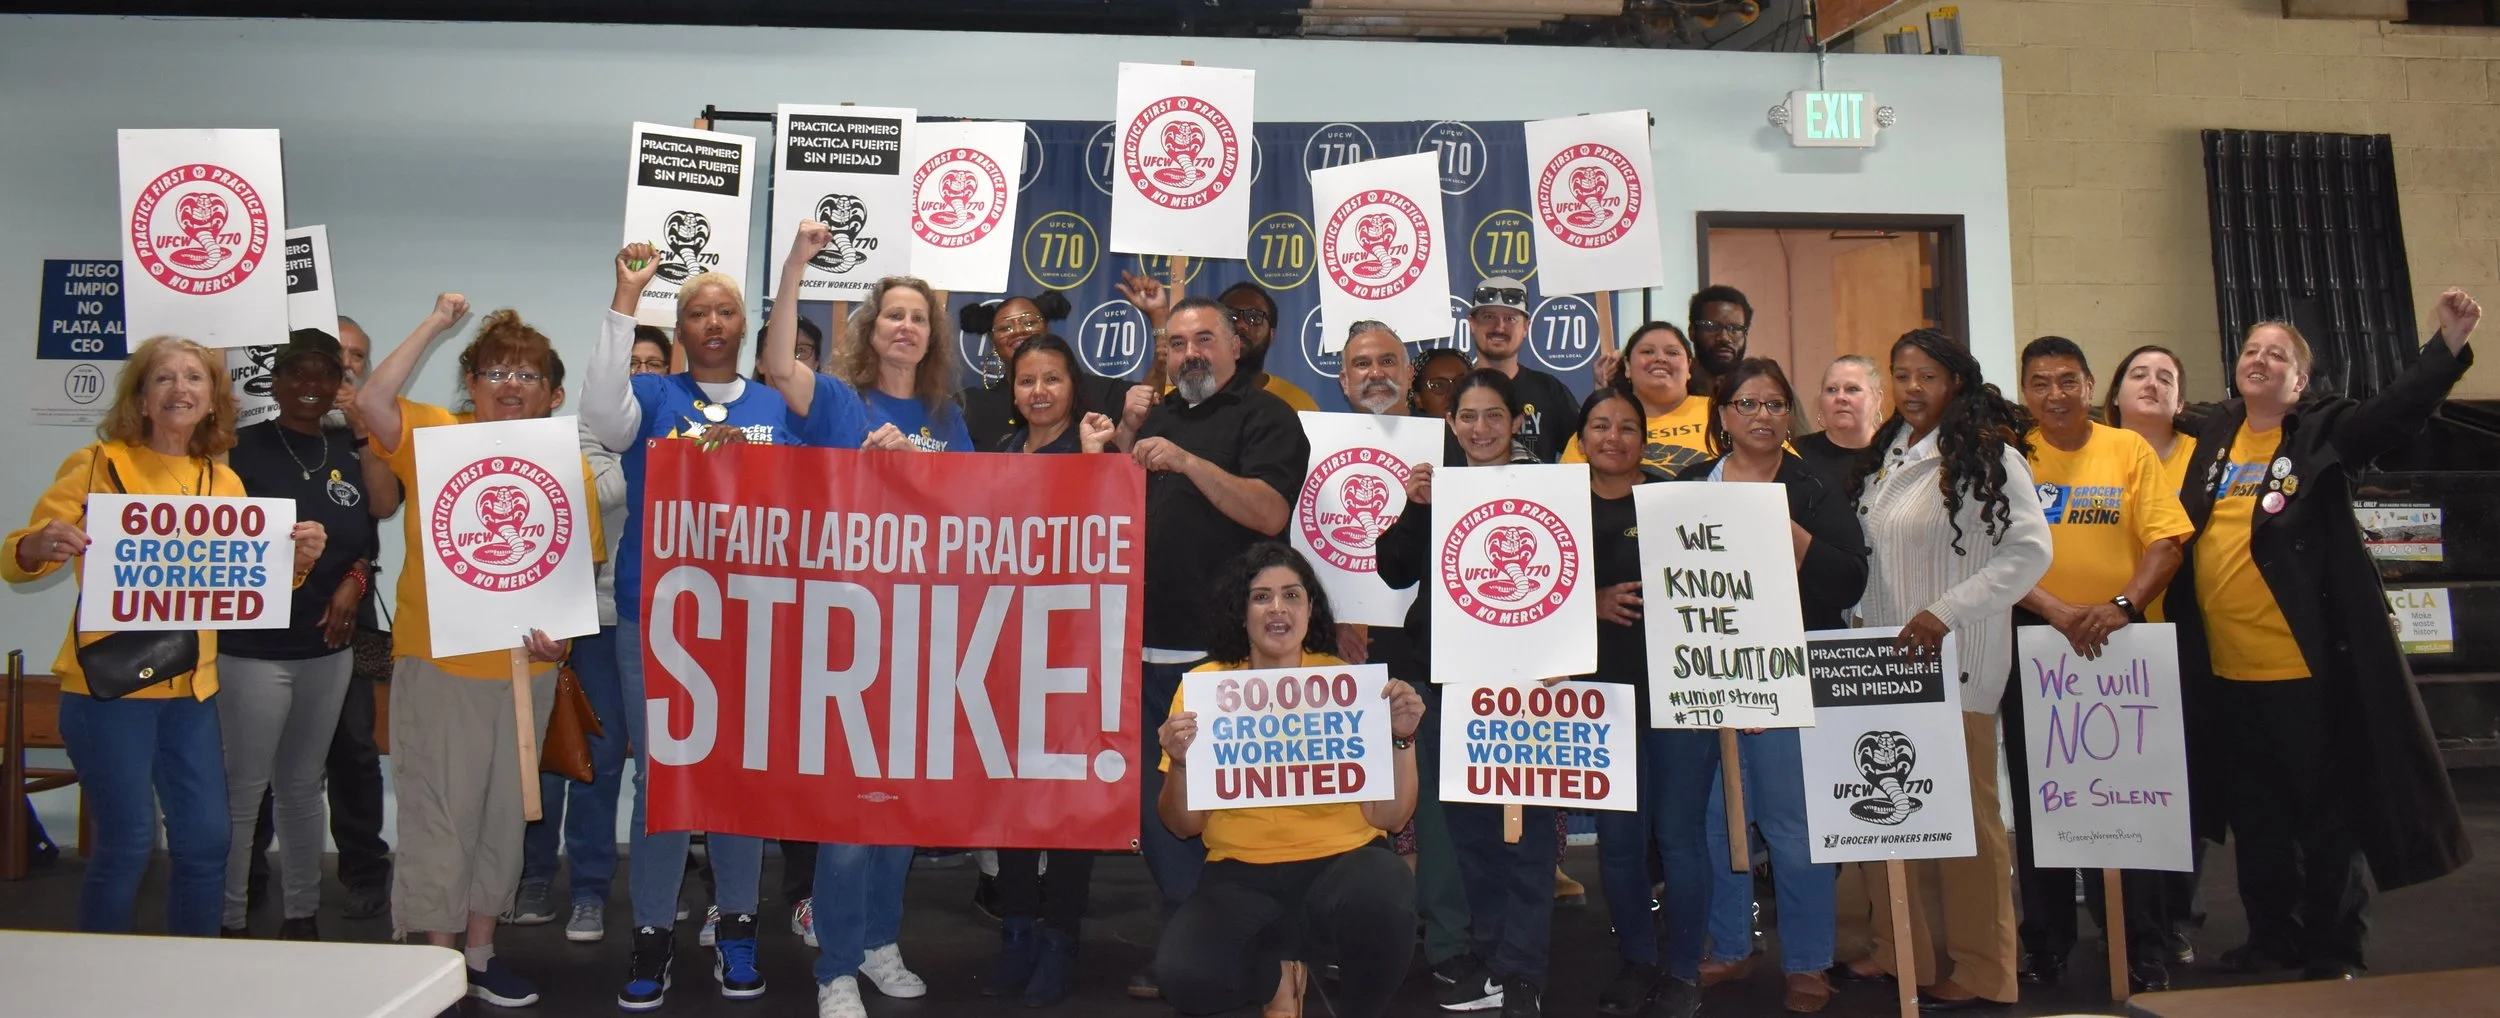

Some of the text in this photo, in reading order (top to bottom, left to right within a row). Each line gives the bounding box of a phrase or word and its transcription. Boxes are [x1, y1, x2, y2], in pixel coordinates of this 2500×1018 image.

[1806, 93, 1863, 138] EXIT
[790, 121, 899, 135] PRACTICA PRIMERO
[1127, 100, 1171, 174] PRACTICE FIRST
[1440, 129, 1463, 137] UFCW
[642, 139, 739, 159] PRACTICA PRIMERO
[789, 136, 899, 151] PRACTICA FUERTE
[1193, 102, 1236, 177] PRACTICE HARD
[641, 154, 739, 174] PRACTICA FUERTE
[804, 151, 882, 166] SIN PIEDAD
[926, 152, 952, 172] FIRST
[1143, 156, 1215, 168] UFCW 770
[1431, 140, 1471, 176] 770
[654, 169, 724, 187] SIN PIEDAD
[969, 153, 1005, 219] PRACTICE HARD
[1540, 149, 1574, 221] PRACTICE FIRST
[1594, 147, 1639, 213] PRACTICE HARD
[921, 201, 985, 211] UFCW 770
[1151, 190, 1208, 207] NO MERCY
[1556, 196, 1620, 213] UFCW 770
[134, 169, 185, 258] PRACTICE FIRST
[211, 169, 265, 254] PRACTICE HARD
[1325, 196, 1361, 272] PRACTICE FIRST
[1382, 193, 1428, 261] PRACTICE HARD
[1567, 228, 1618, 246] NO MERCY
[156, 233, 241, 248] UFCW 770
[855, 237, 878, 250] 770
[925, 231, 975, 246] NO MERCY
[1487, 231, 1529, 265] 770
[699, 253, 719, 265] 770
[1040, 233, 1084, 269] 770
[1260, 234, 1304, 269] 770
[1341, 244, 1408, 264] UFCW 770
[66, 264, 119, 278] JUEGO
[286, 258, 312, 271] ERTE
[64, 282, 119, 296] LIMPIO
[169, 271, 236, 292] NO MERCY
[799, 280, 862, 289] ROCERY WORKERS
[1352, 277, 1406, 297] NO MERCY
[642, 290, 673, 299] GROCERY
[77, 301, 103, 315] NO
[52, 320, 125, 334] PLATA AL
[1544, 315, 1586, 350] 770
[71, 339, 104, 353] CEO
[1095, 321, 1136, 358] 770
[73, 376, 96, 393] 770
[231, 366, 260, 381] UFCW
[740, 424, 774, 434] OCERY
[1647, 424, 1702, 439] ESIST
[1302, 451, 1353, 531] PRACTICE FIRST
[2074, 486, 2124, 497] GROCERY
[435, 463, 483, 557] PRACTICE FIRST
[510, 461, 569, 544] PRACTICE HARD
[120, 502, 265, 538] 60,000
[1320, 512, 1352, 525] UFCW
[2068, 510, 2120, 524] RISING
[457, 524, 545, 547] UFCW 770
[654, 500, 1132, 574] UNFAIR LABOR PRACTICE
[1445, 504, 1495, 589] PRACTICE FIRST
[1520, 504, 1575, 586] PRACTICE HARD
[1676, 523, 1727, 552] WE
[115, 539, 270, 563] GROCERY
[1328, 551, 1377, 569] NO MER
[114, 565, 267, 587] WORKERS
[473, 564, 542, 588] NO MERCY
[1465, 565, 1550, 580] UFCW 770
[1664, 567, 1754, 601] KNOW
[112, 590, 264, 622] UNITED
[1476, 604, 1545, 624] NO MERCY
[1675, 606, 1739, 635] THE
[1673, 644, 1805, 683] SOLUTION
[1810, 647, 1875, 660] PRACTICA
[647, 565, 1128, 783] STRIKE!
[1812, 665, 1883, 679] PRACTICA
[2033, 653, 2150, 700] We will
[1215, 673, 1358, 713] 60,000
[1832, 679, 1923, 697] SIN PIEDAD
[1471, 687, 1605, 720] 60,000
[1212, 710, 1364, 740] GROCERY
[1467, 719, 1611, 745] GROCERY
[2046, 701, 2158, 768] NOT
[1213, 736, 1366, 765] WORKERS
[1466, 742, 1611, 768] WORKERS
[1215, 762, 1366, 800] UNITED
[1467, 766, 1610, 801] UNITED
[1833, 778, 1933, 800] UFCW 770
[2039, 781, 2077, 813] BE
[1840, 832, 1952, 845] GROCERY WORKERS RISING
